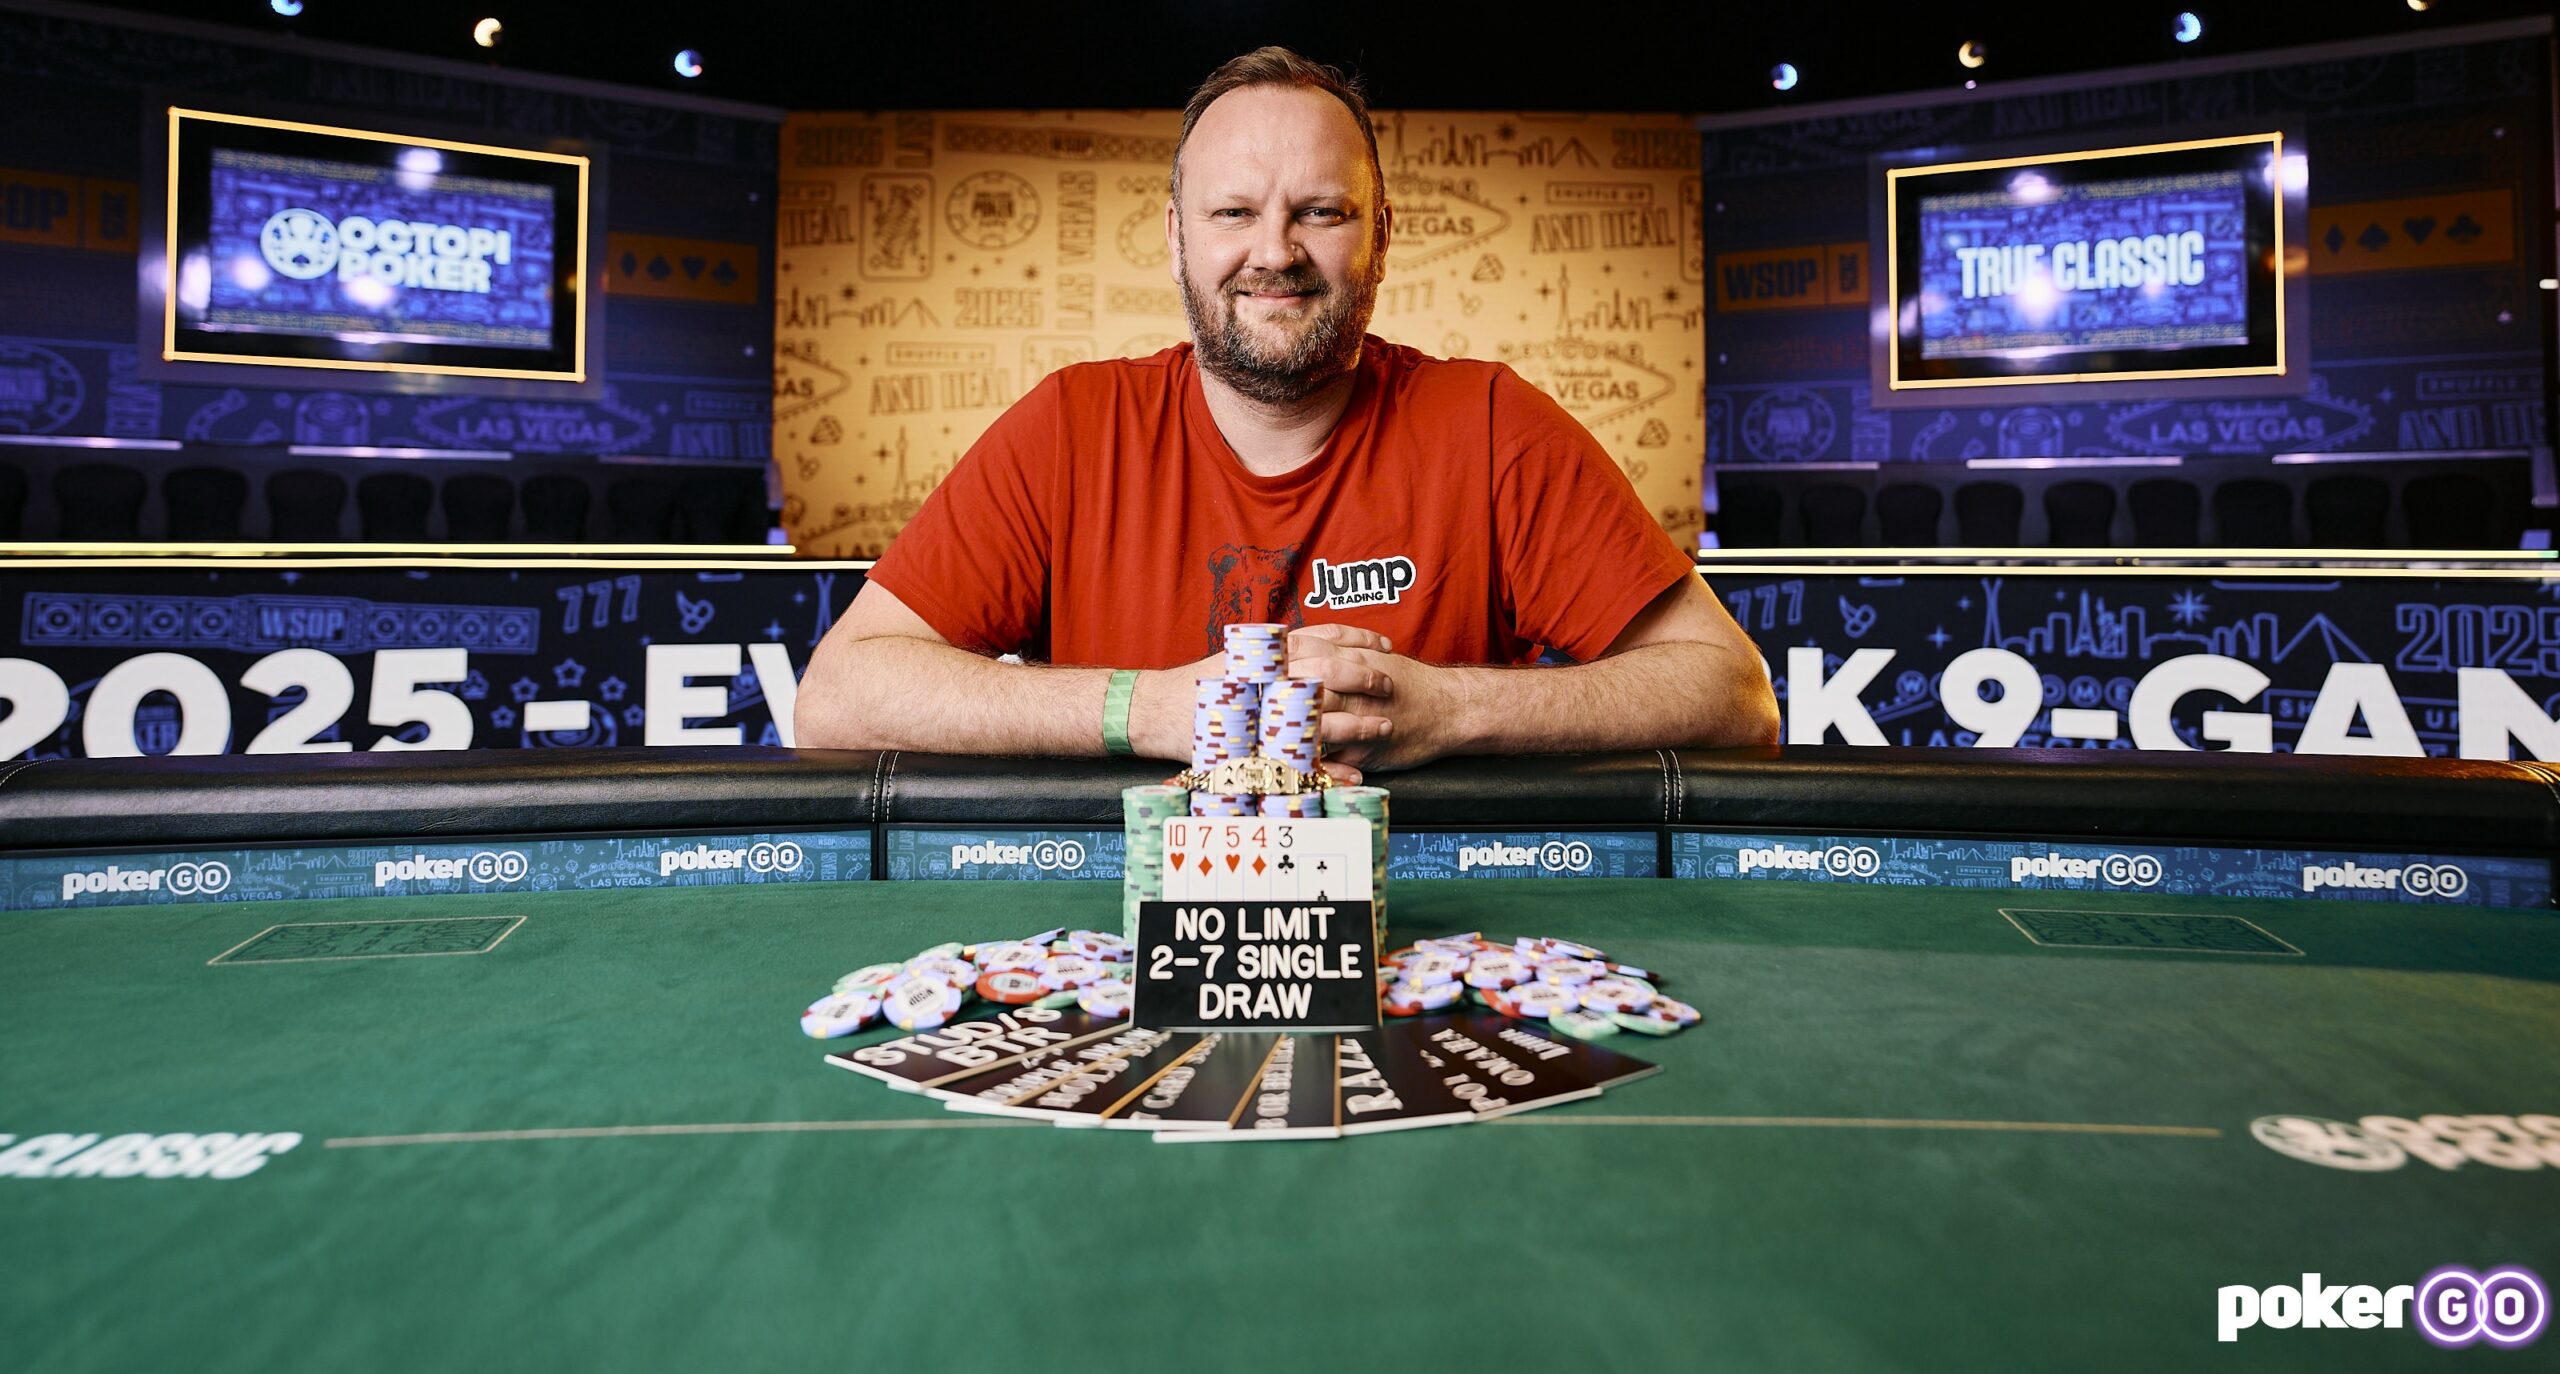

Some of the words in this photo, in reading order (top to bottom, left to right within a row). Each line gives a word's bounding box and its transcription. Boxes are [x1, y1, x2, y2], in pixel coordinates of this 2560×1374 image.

[0, 183, 69, 231] OP
[337, 215, 512, 265] OCTOPI
[337, 251, 491, 293] POKER
[1723, 258, 1818, 300] WSOP
[1957, 242, 2046, 300] TRUE
[2051, 231, 2206, 291] CLASSIC
[954, 288, 1044, 328] 2025
[1556, 380, 1640, 400] VEGAS
[457, 416, 513, 440] LAS
[519, 417, 615, 444] VEGAS
[2151, 421, 2210, 445] LAS
[2217, 416, 2325, 443] VEGAS
[1308, 557, 1414, 606] Jump
[1331, 591, 1384, 606] TRADING
[556, 575, 642, 634] 777
[1727, 580, 1805, 631] 777
[260, 608, 344, 639] WSOP
[1168, 825, 1186, 847] 10
[1199, 826, 1213, 848] 7
[1225, 825, 1240, 848] 5
[1251, 825, 1268, 848] 4
[1278, 826, 1293, 848] 3
[374, 851, 529, 894] pokerGO
[660, 840, 804, 877] pokerGO
[951, 839, 1086, 871] pokerGO
[1458, 840, 1593, 872] pokerGO
[1738, 844, 1881, 877] pokerGO
[2011, 852, 2163, 887] pokerGO
[62, 861, 232, 901] pokerGO
[590, 878, 612, 888] LAS
[614, 876, 653, 887] VEGAS
[1071, 870, 1093, 878] LAS
[1095, 869, 1126, 879] VEGAS
[1395, 871, 1415, 880] LAS
[1417, 870, 1451, 880] VEGAS
[2303, 861, 2469, 898] pokerGO
[241, 890, 283, 901] VEGAS
[2227, 889, 2250, 897] LAS
[2253, 890, 2294, 899] VEGAS
[1175, 908, 1225, 941] NO
[1238, 907, 1335, 941] LIMIT
[1149, 945, 1225, 980] 2-7
[1237, 944, 1363, 979] SINGLE
[1199, 983, 1313, 1020] DRAW
[852, 1006, 1063, 1067] STUD/8
[935, 1026, 1072, 1068] BTR
[1430, 1027, 1535, 1086] OMAHA
